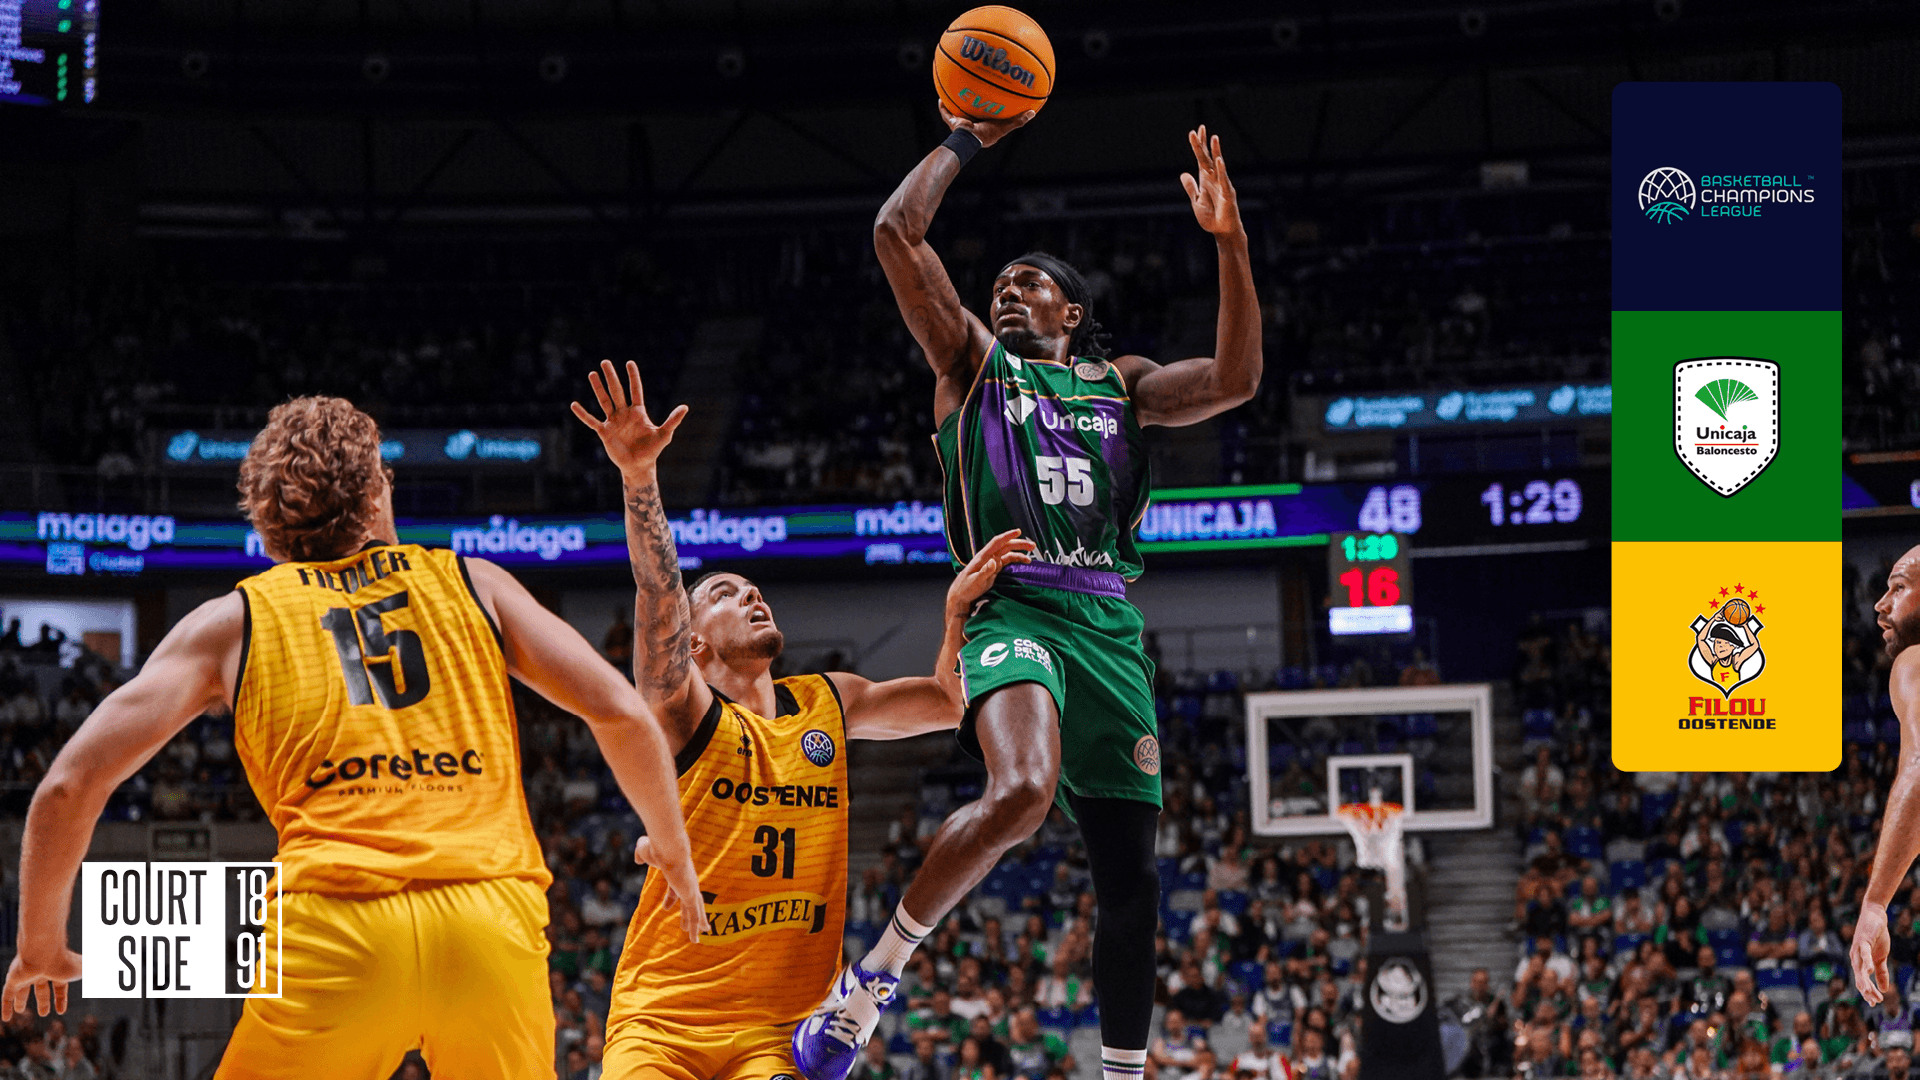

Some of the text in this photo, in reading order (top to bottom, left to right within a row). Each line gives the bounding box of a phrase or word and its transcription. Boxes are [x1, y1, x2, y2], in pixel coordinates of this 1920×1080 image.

[960, 35, 1036, 89] Wilson
[1042, 411, 1118, 439] Uncaja
[1035, 455, 1094, 507] 55
[1481, 479, 1582, 526] 1:29
[1139, 500, 1277, 541] UNICAJA
[1358, 485, 1422, 534] 48
[1340, 567, 1400, 608] 16
[320, 590, 431, 710] 15
[339, 783, 463, 796] PREMIUM FLOORS
[711, 777, 839, 808] OOSTENDE
[751, 825, 796, 879] 31
[701, 899, 811, 936] KASTEEL
